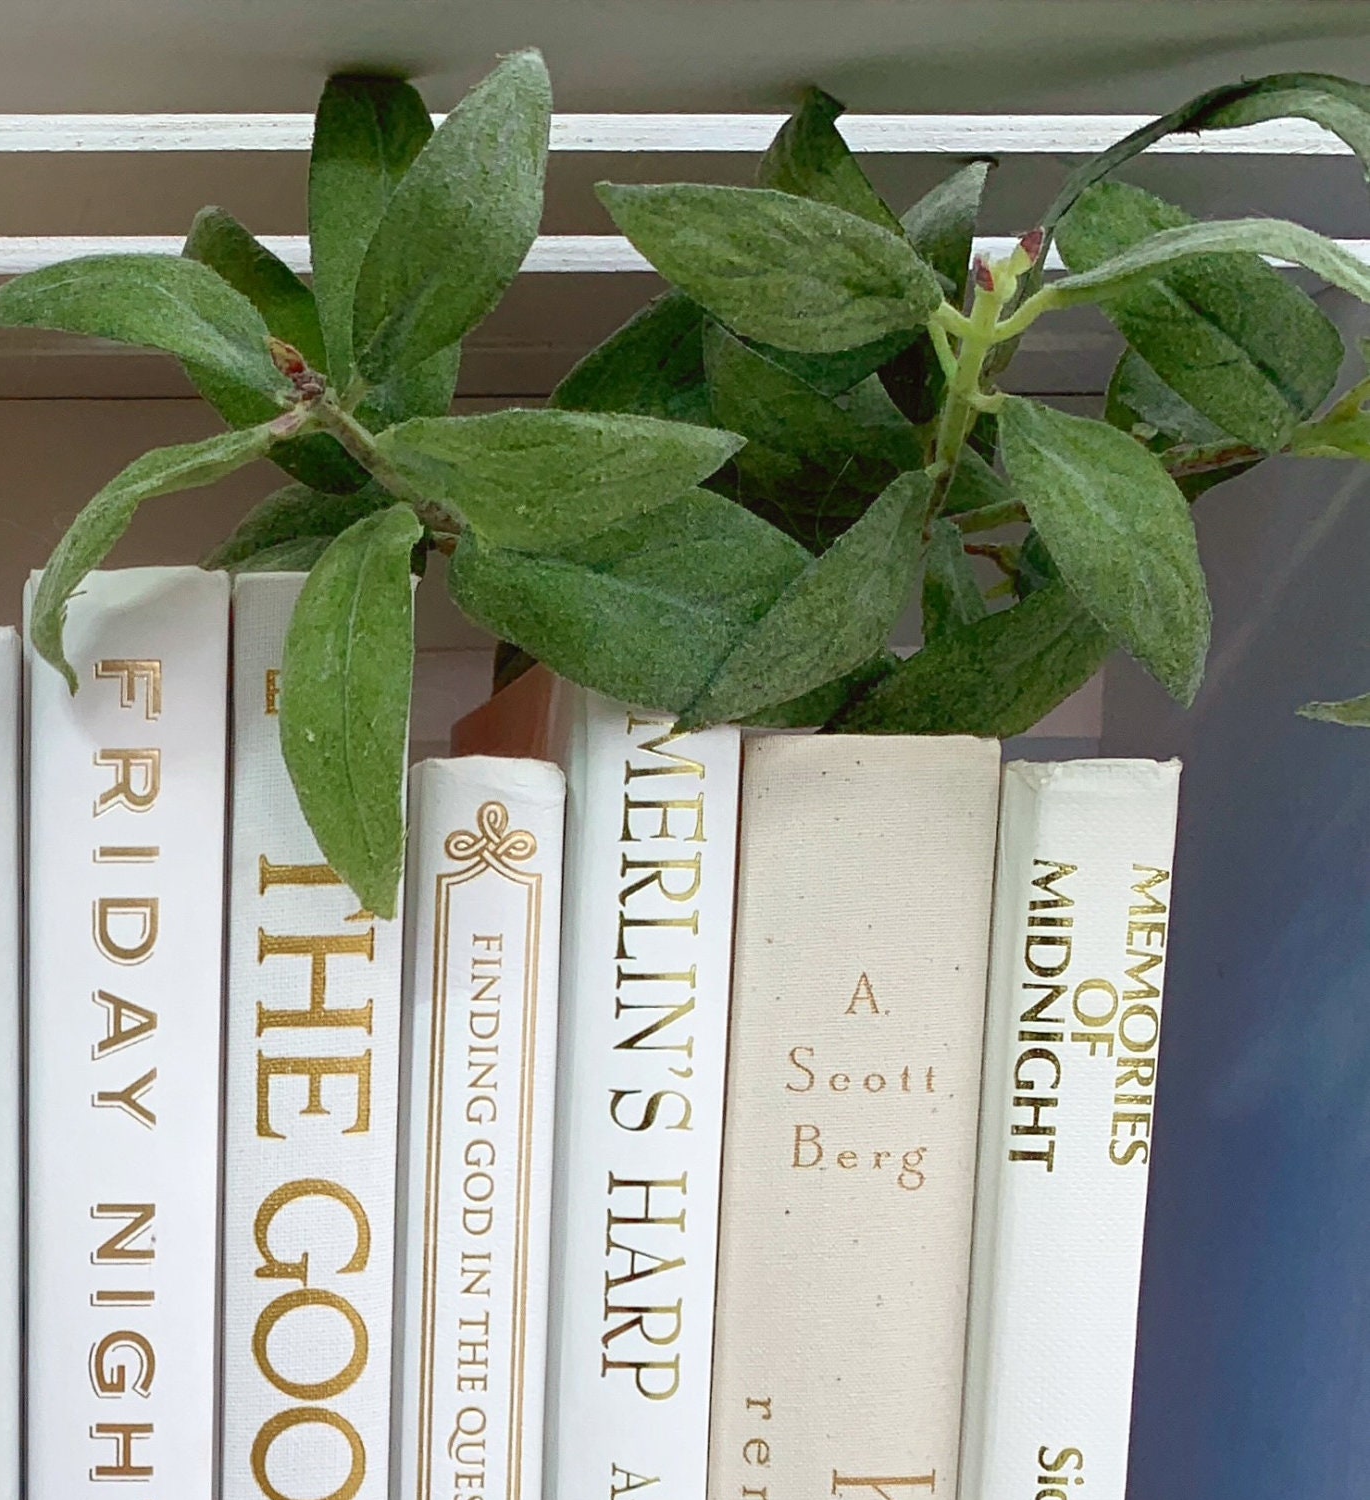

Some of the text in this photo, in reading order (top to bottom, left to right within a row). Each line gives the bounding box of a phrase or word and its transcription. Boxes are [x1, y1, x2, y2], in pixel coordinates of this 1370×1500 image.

[91, 659, 162, 1129] FRIDAY
[465, 933, 503, 1125] FINDING
[845, 972, 890, 1016] A.
[1008, 859, 1078, 1172] MIDNIGHT
[1070, 978, 1120, 1058] OF
[1109, 863, 1170, 1167] MEMORIES
[600, 711, 708, 1400] MERLIN'S HARP
[786, 1048, 936, 1094] Scott
[462, 1140, 496, 1236] GOD
[791, 1124, 928, 1192] Berg
[460, 1252, 491, 1298] IN
[457, 1311, 490, 1393] THE
